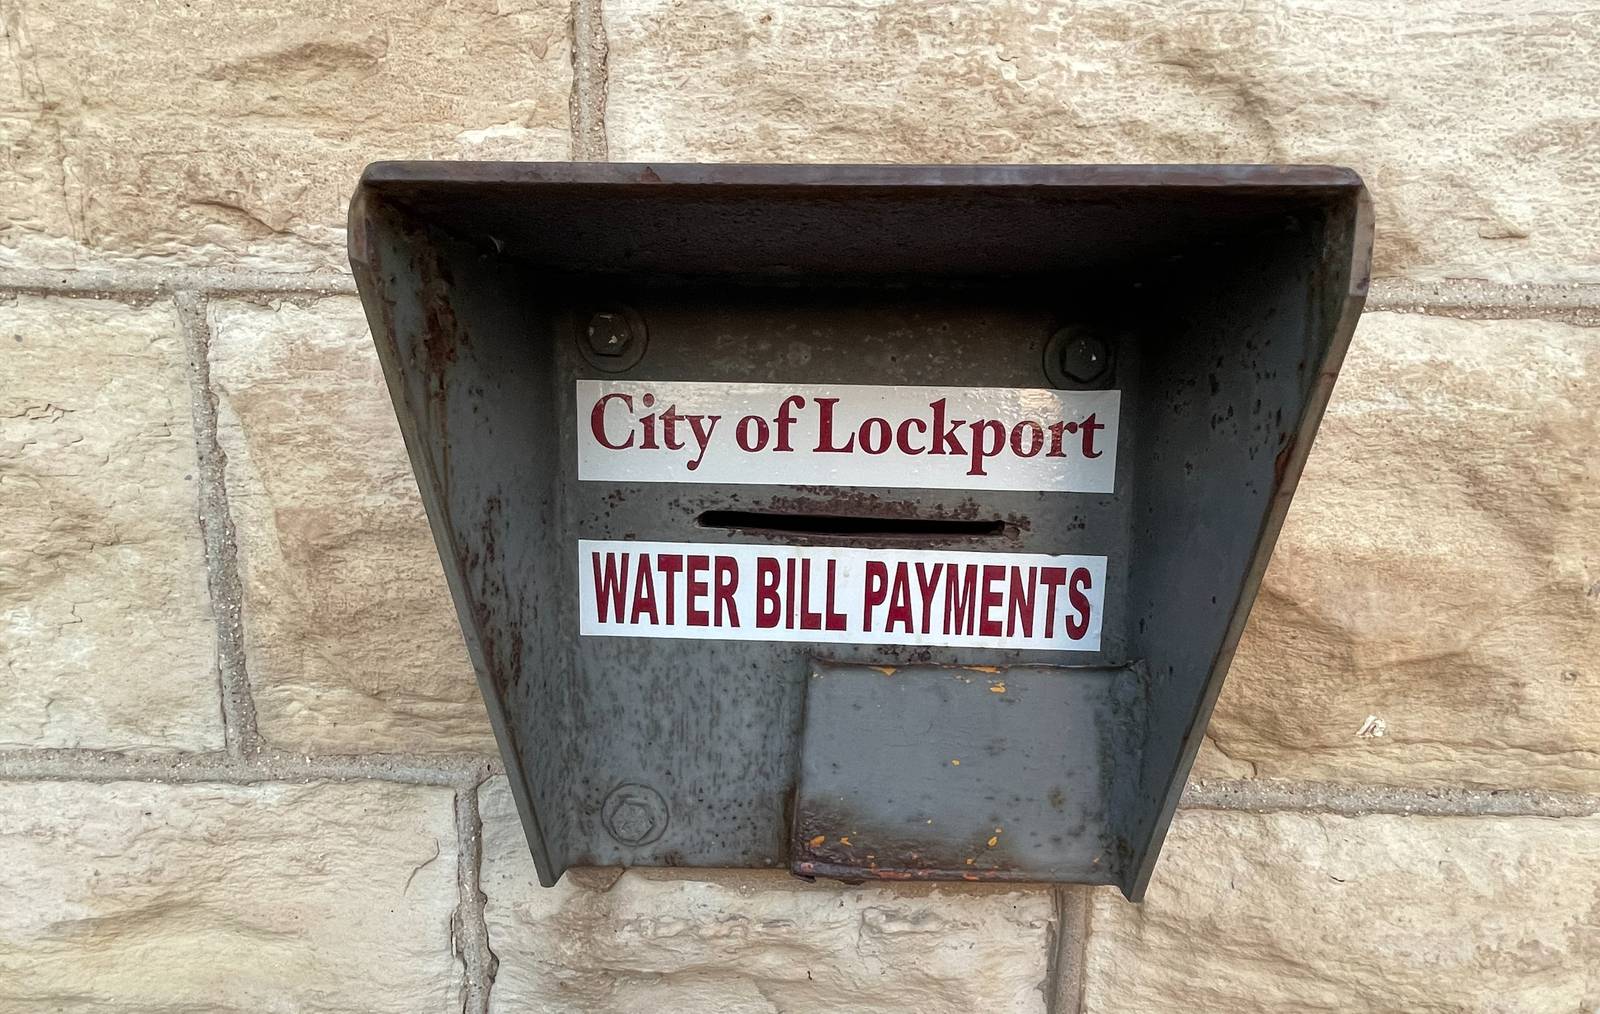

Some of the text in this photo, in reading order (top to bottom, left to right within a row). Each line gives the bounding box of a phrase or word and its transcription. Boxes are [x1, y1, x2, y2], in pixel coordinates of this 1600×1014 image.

[590, 393, 1105, 476] City of Lockport
[591, 551, 1093, 641] WATER BILL PAYMENTS
